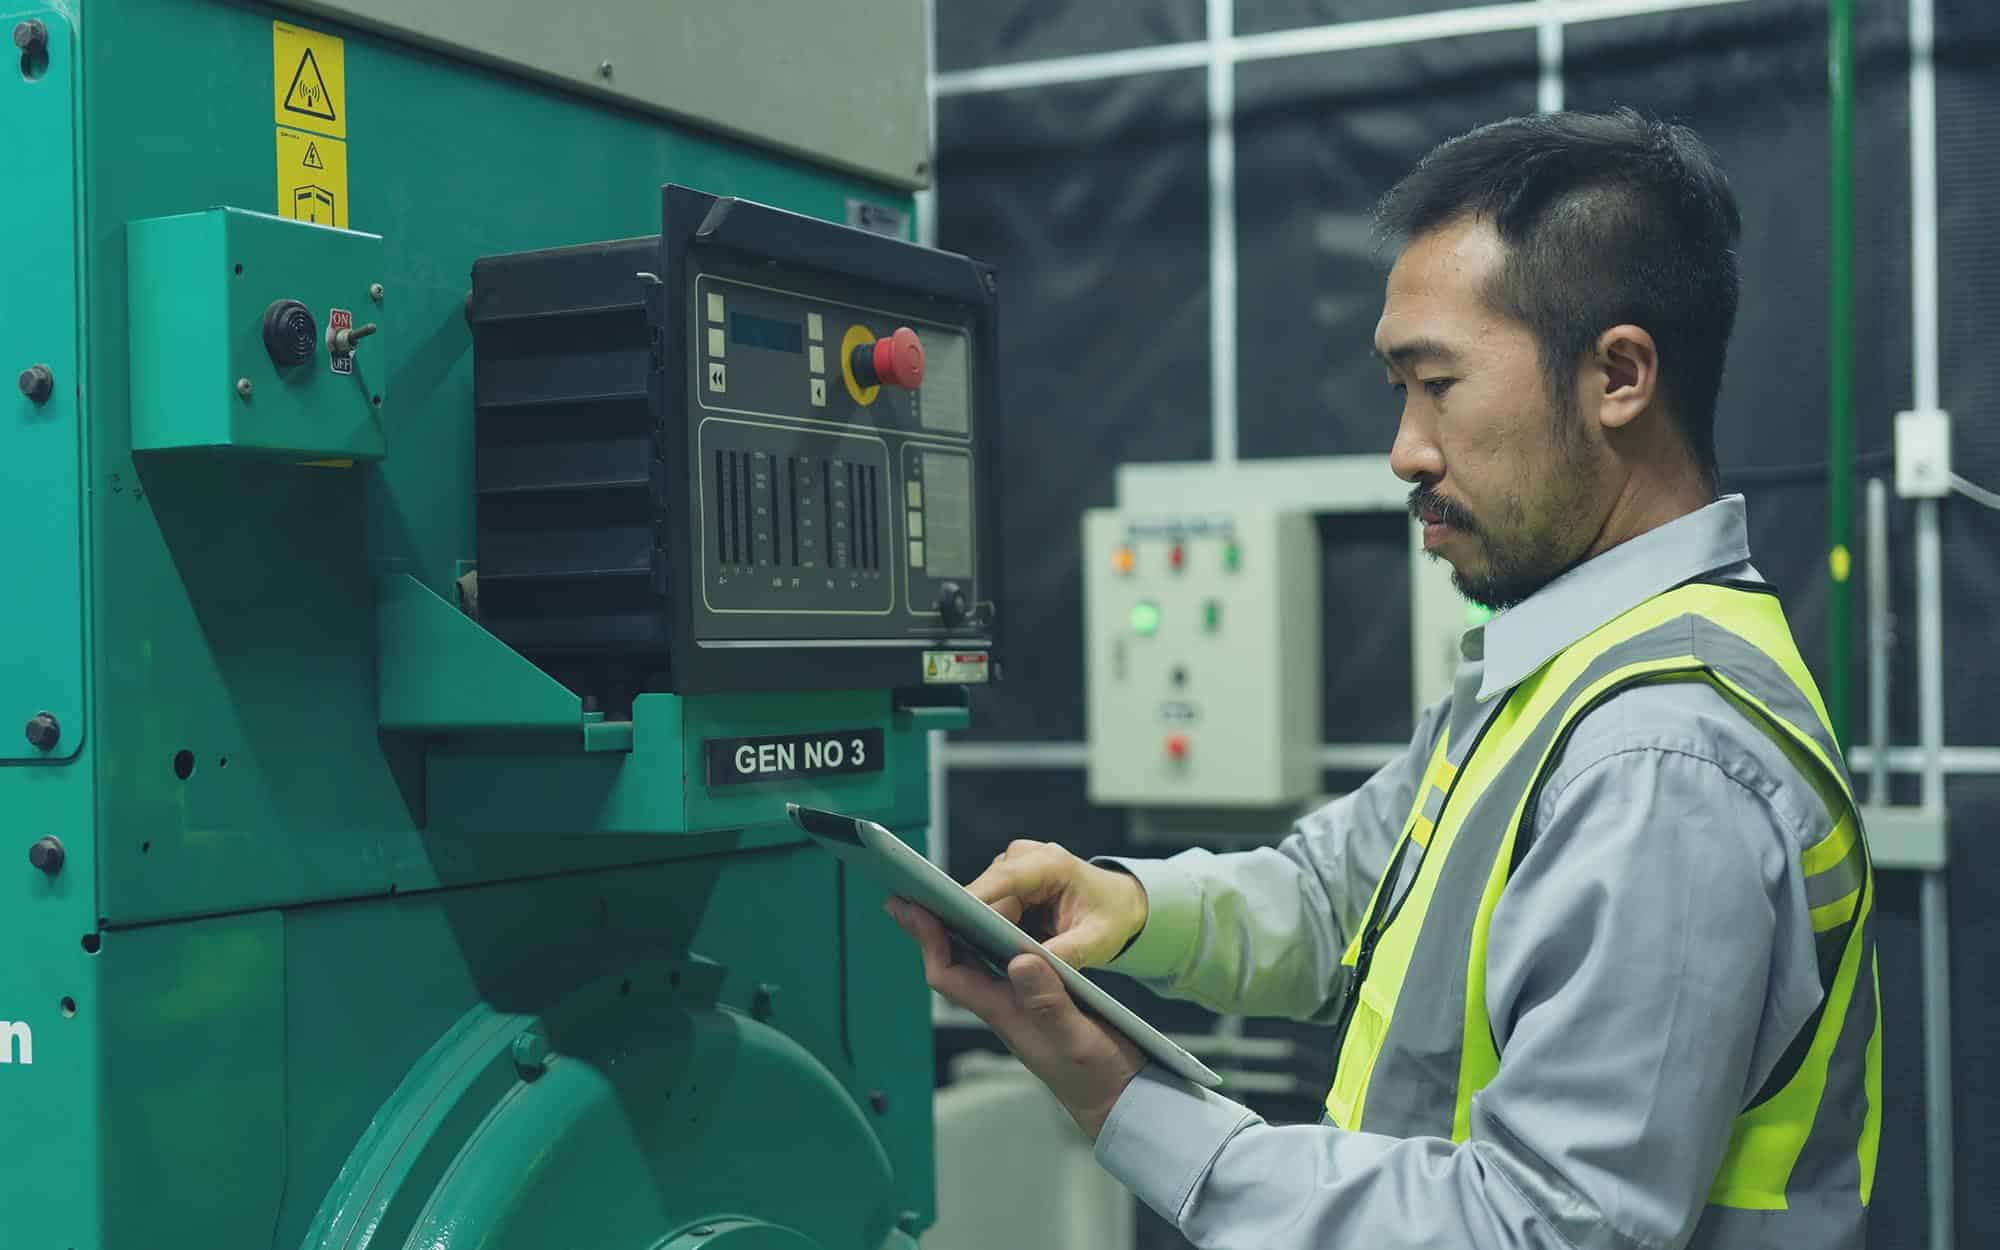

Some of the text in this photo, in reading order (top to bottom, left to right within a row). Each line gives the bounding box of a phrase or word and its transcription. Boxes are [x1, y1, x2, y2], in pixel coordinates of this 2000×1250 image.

[333, 312, 349, 326] ON
[333, 357, 351, 370] OFF
[735, 738, 866, 774] GEN NO 3
